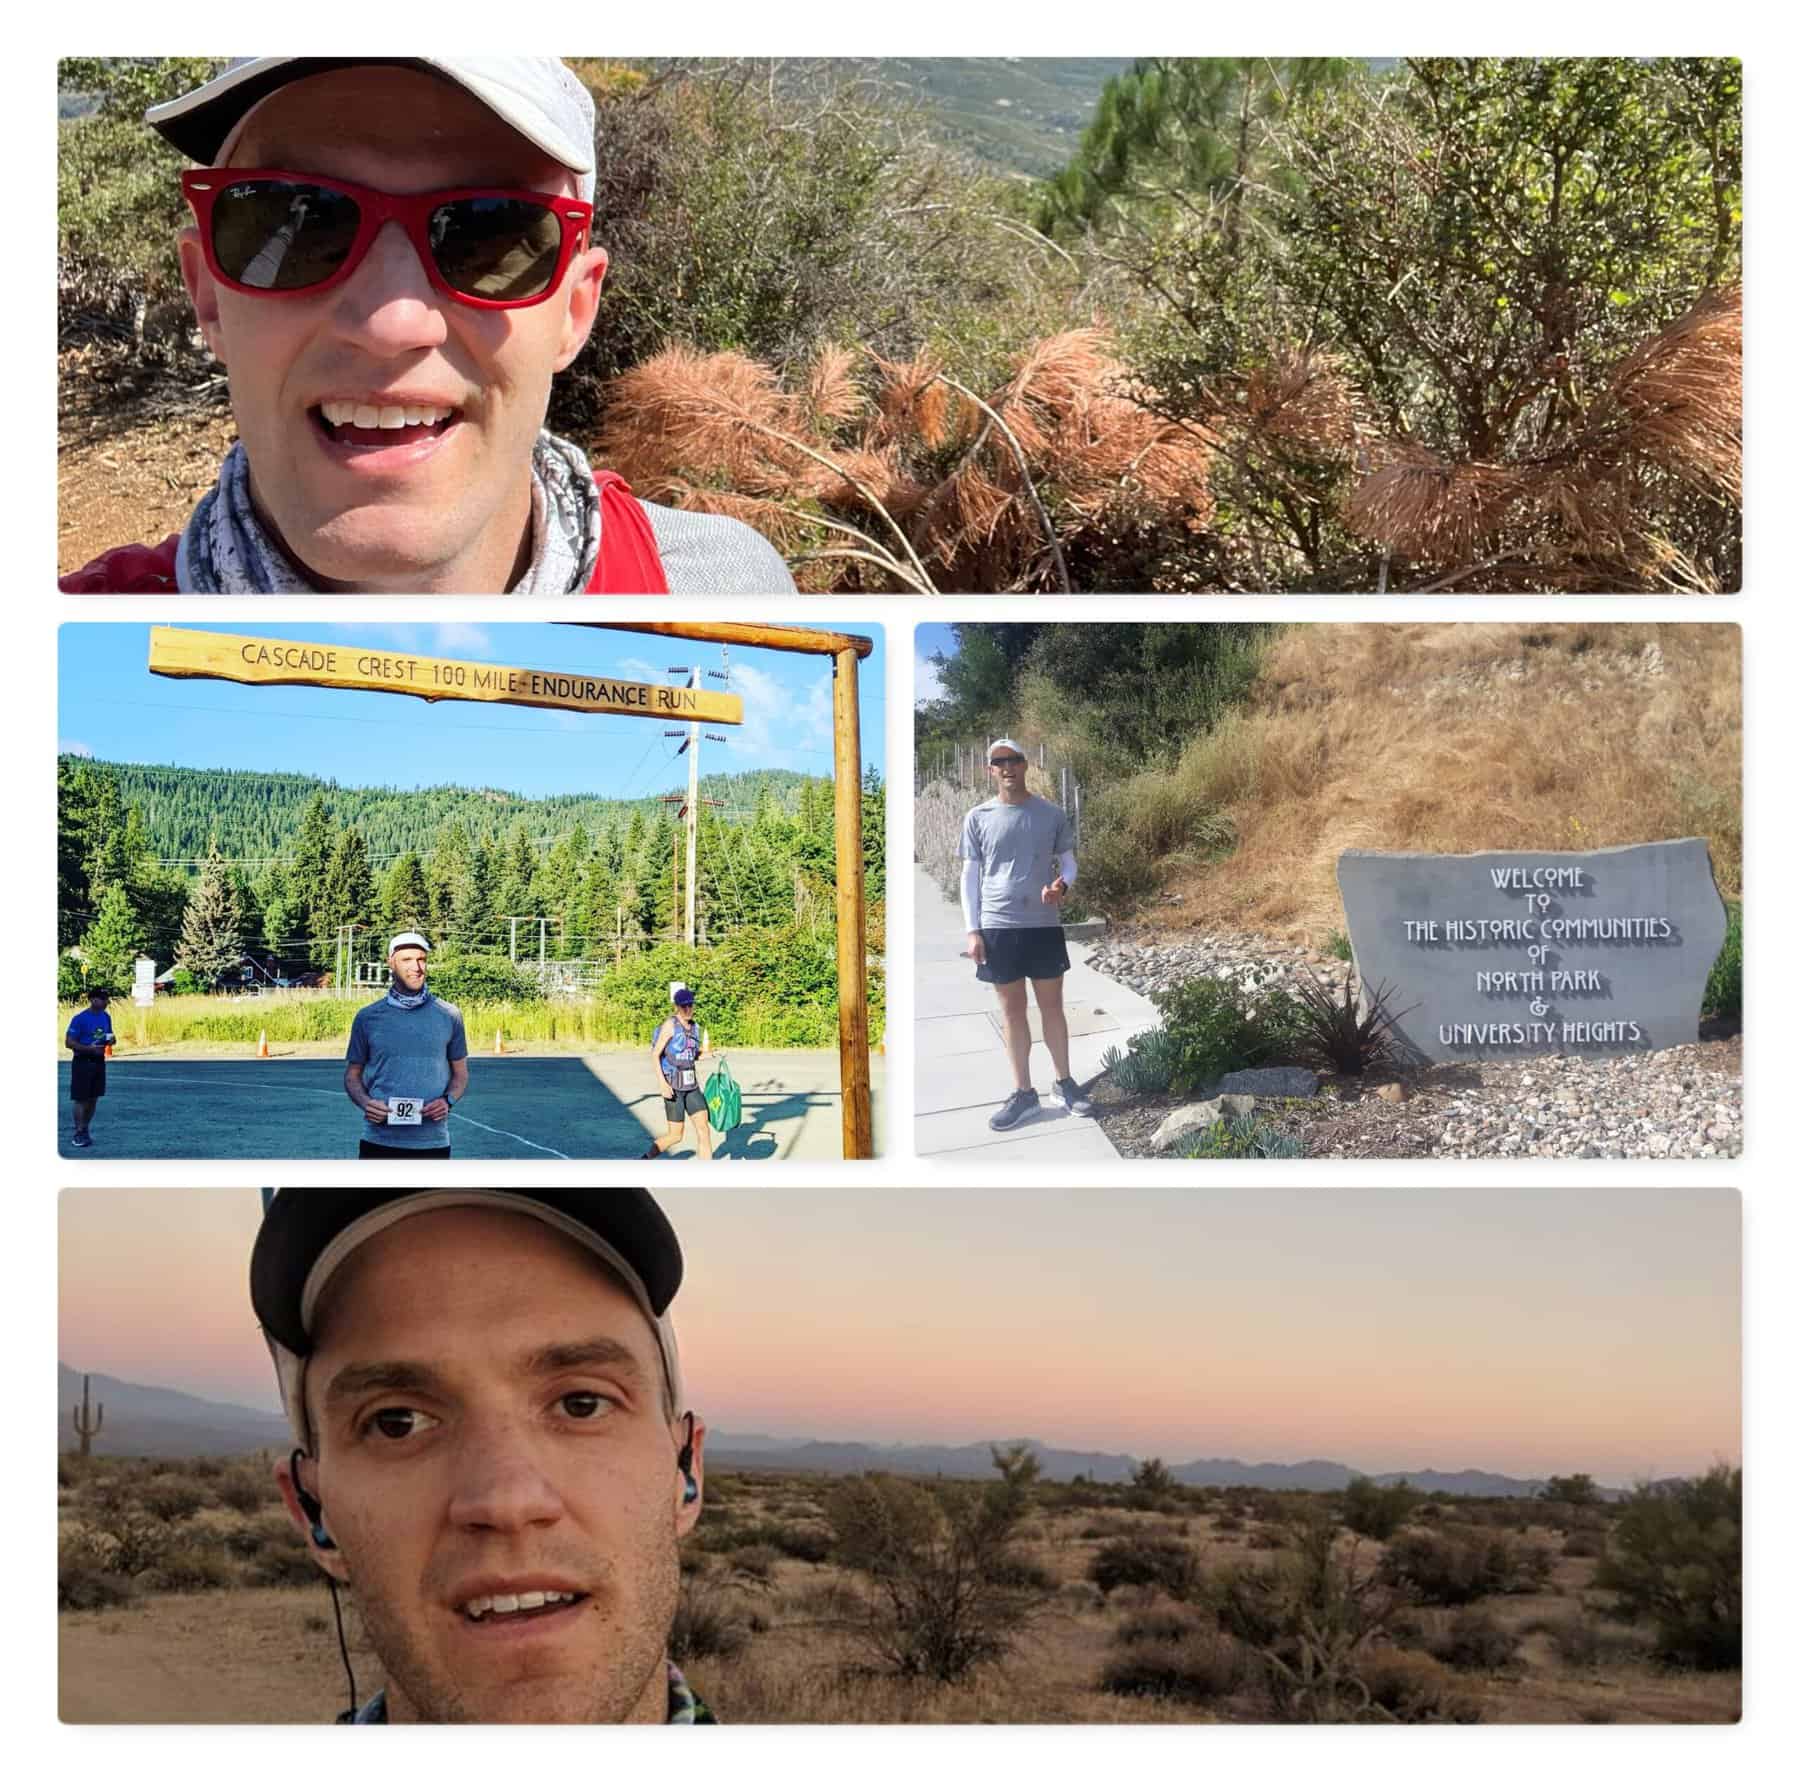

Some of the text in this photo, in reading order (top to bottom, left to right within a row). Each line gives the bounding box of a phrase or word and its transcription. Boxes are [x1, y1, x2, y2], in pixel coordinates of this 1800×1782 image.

[241, 643, 697, 711] CASCADE CREST 100 MILE ENDURANCE RUN
[1490, 867, 1585, 888] WELCOME
[1525, 893, 1551, 914] TO
[1404, 917, 1672, 942] THE HISTORIC COMMUNITIES
[1527, 943, 1550, 965] OF
[1476, 970, 1601, 993] NORTH PARK
[1528, 996, 1550, 1017] &
[1439, 1019, 1642, 1045] UNIVERSITY HEIGHTS
[397, 1103, 413, 1117] 92
